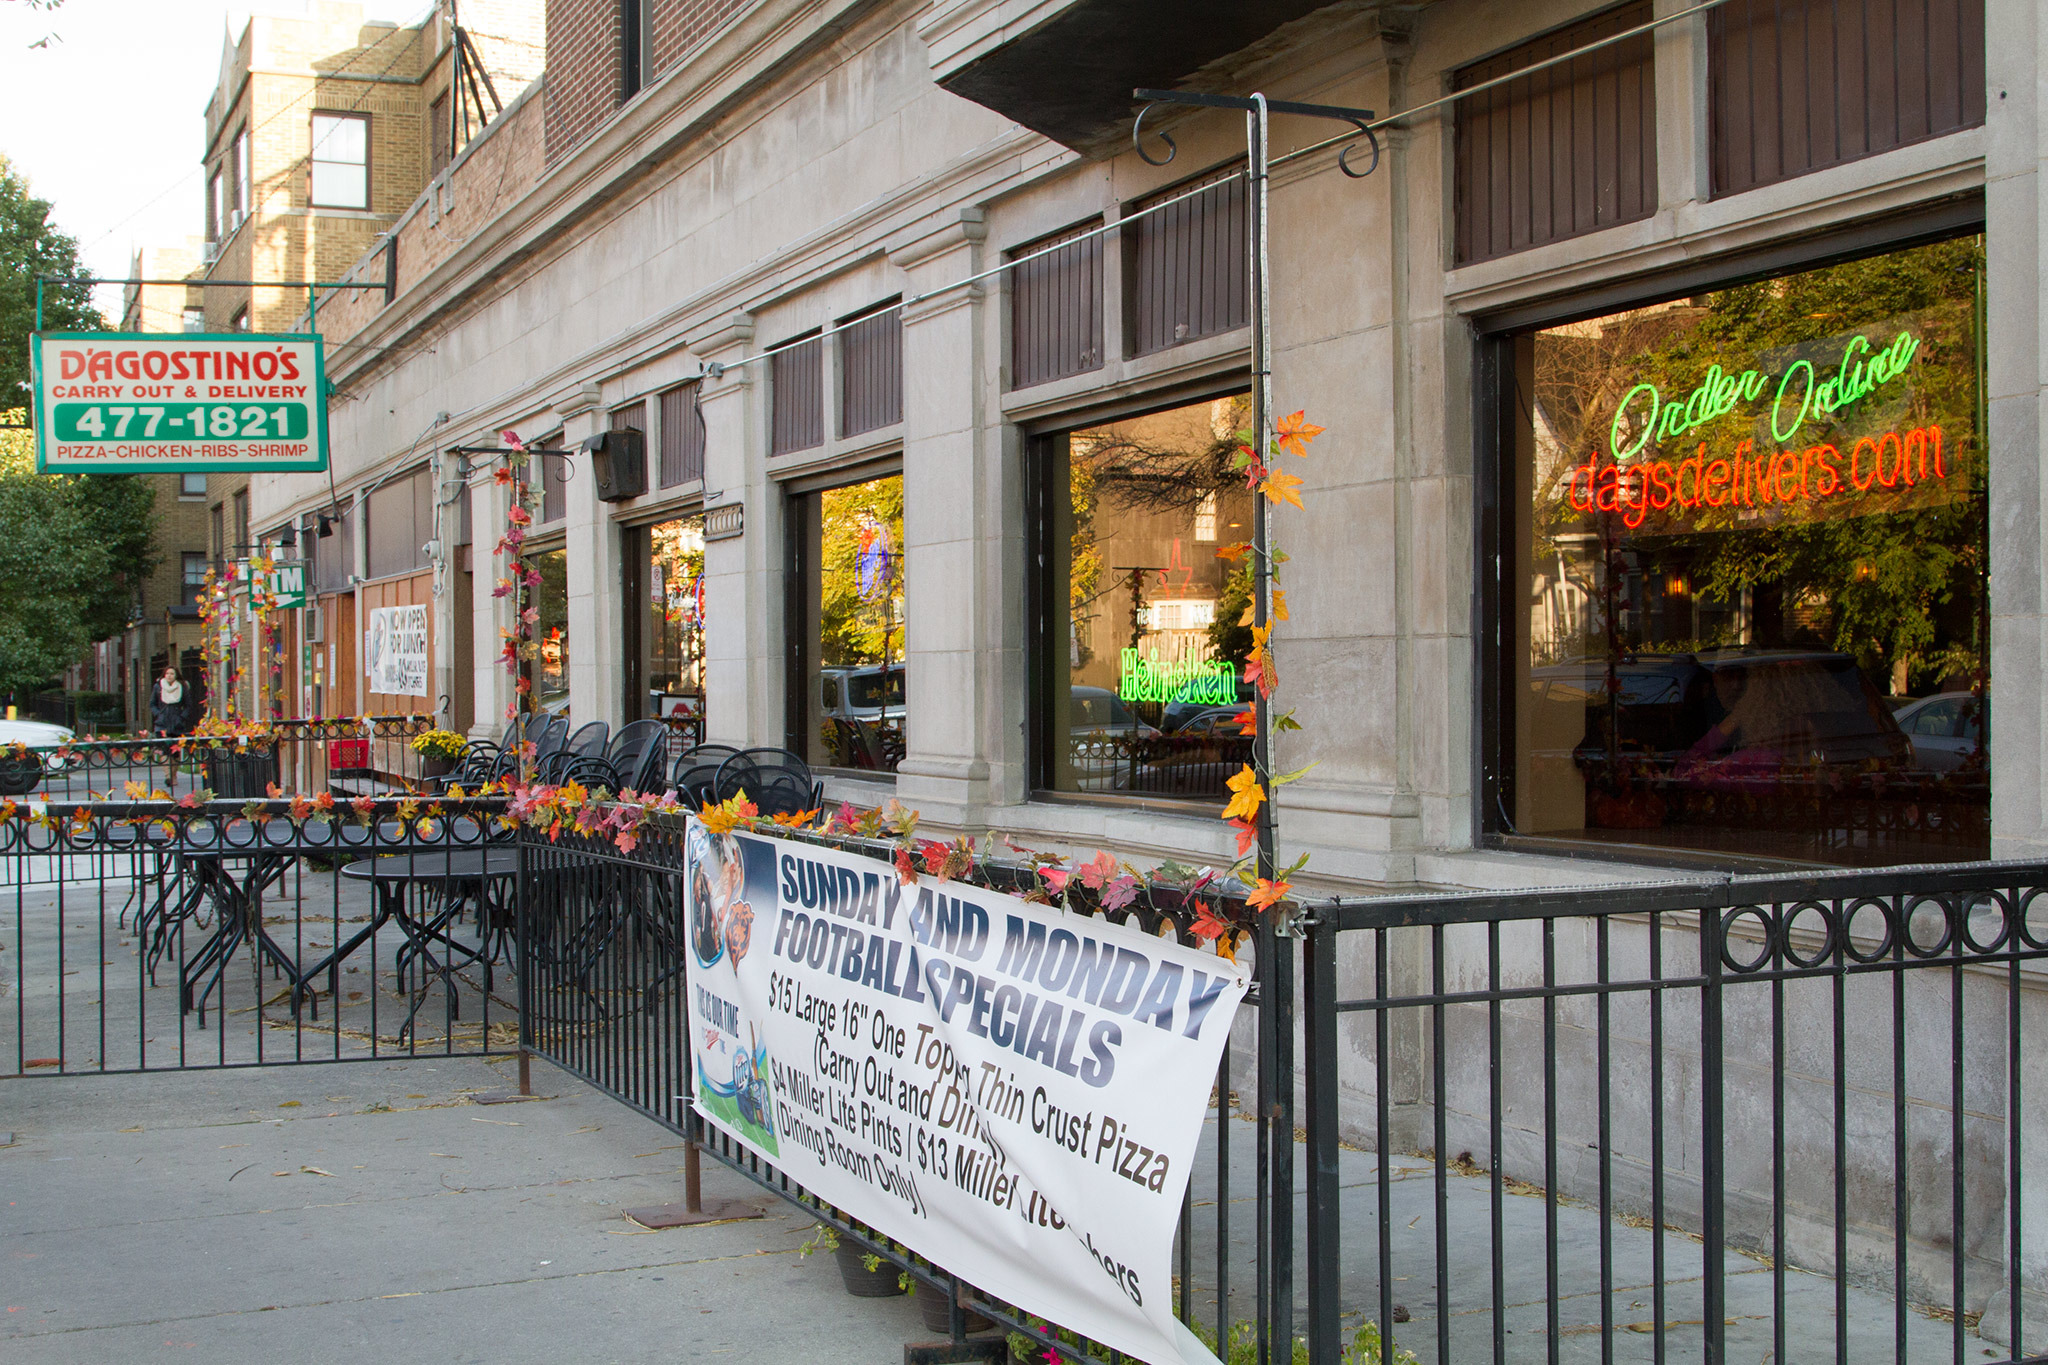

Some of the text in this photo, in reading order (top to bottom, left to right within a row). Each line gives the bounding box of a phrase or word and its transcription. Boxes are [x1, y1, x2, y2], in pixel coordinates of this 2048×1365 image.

[52, 385, 307, 398] CARRY OUT & DELIVERY
[60, 346, 300, 383] D'AGOSTINO'S
[1610, 331, 1920, 460] Order Online
[75, 406, 290, 438] 477-1821
[1569, 424, 1946, 530] dagsdelivers.com
[252, 567, 303, 594] ATM
[408, 608, 425, 630] OPEN
[1120, 647, 1238, 706] Heineken
[781, 854, 1231, 1041] SUNDAY AND MONDAY
[723, 1000, 739, 1039] TIME
[773, 908, 1122, 1089] FOOTBALL SPECIALS
[769, 969, 793, 1014] $15
[795, 981, 837, 1038] Large
[872, 1009, 906, 1059] One
[978, 1060, 1024, 1125] Thin
[1031, 1086, 1093, 1159] Crust
[1095, 1115, 1170, 1195] Pizza
[814, 1034, 859, 1099] (Carry
[864, 1055, 894, 1106] Out
[898, 1080, 938, 1122] and
[771, 1055, 787, 1097] $4
[787, 1065, 825, 1117] Miller
[829, 1086, 856, 1134] Lite
[861, 1100, 902, 1158] Pints
[917, 1125, 948, 1181] $13
[955, 1144, 1020, 1211] Miller
[776, 1099, 927, 1220] (Dining Room Only)
